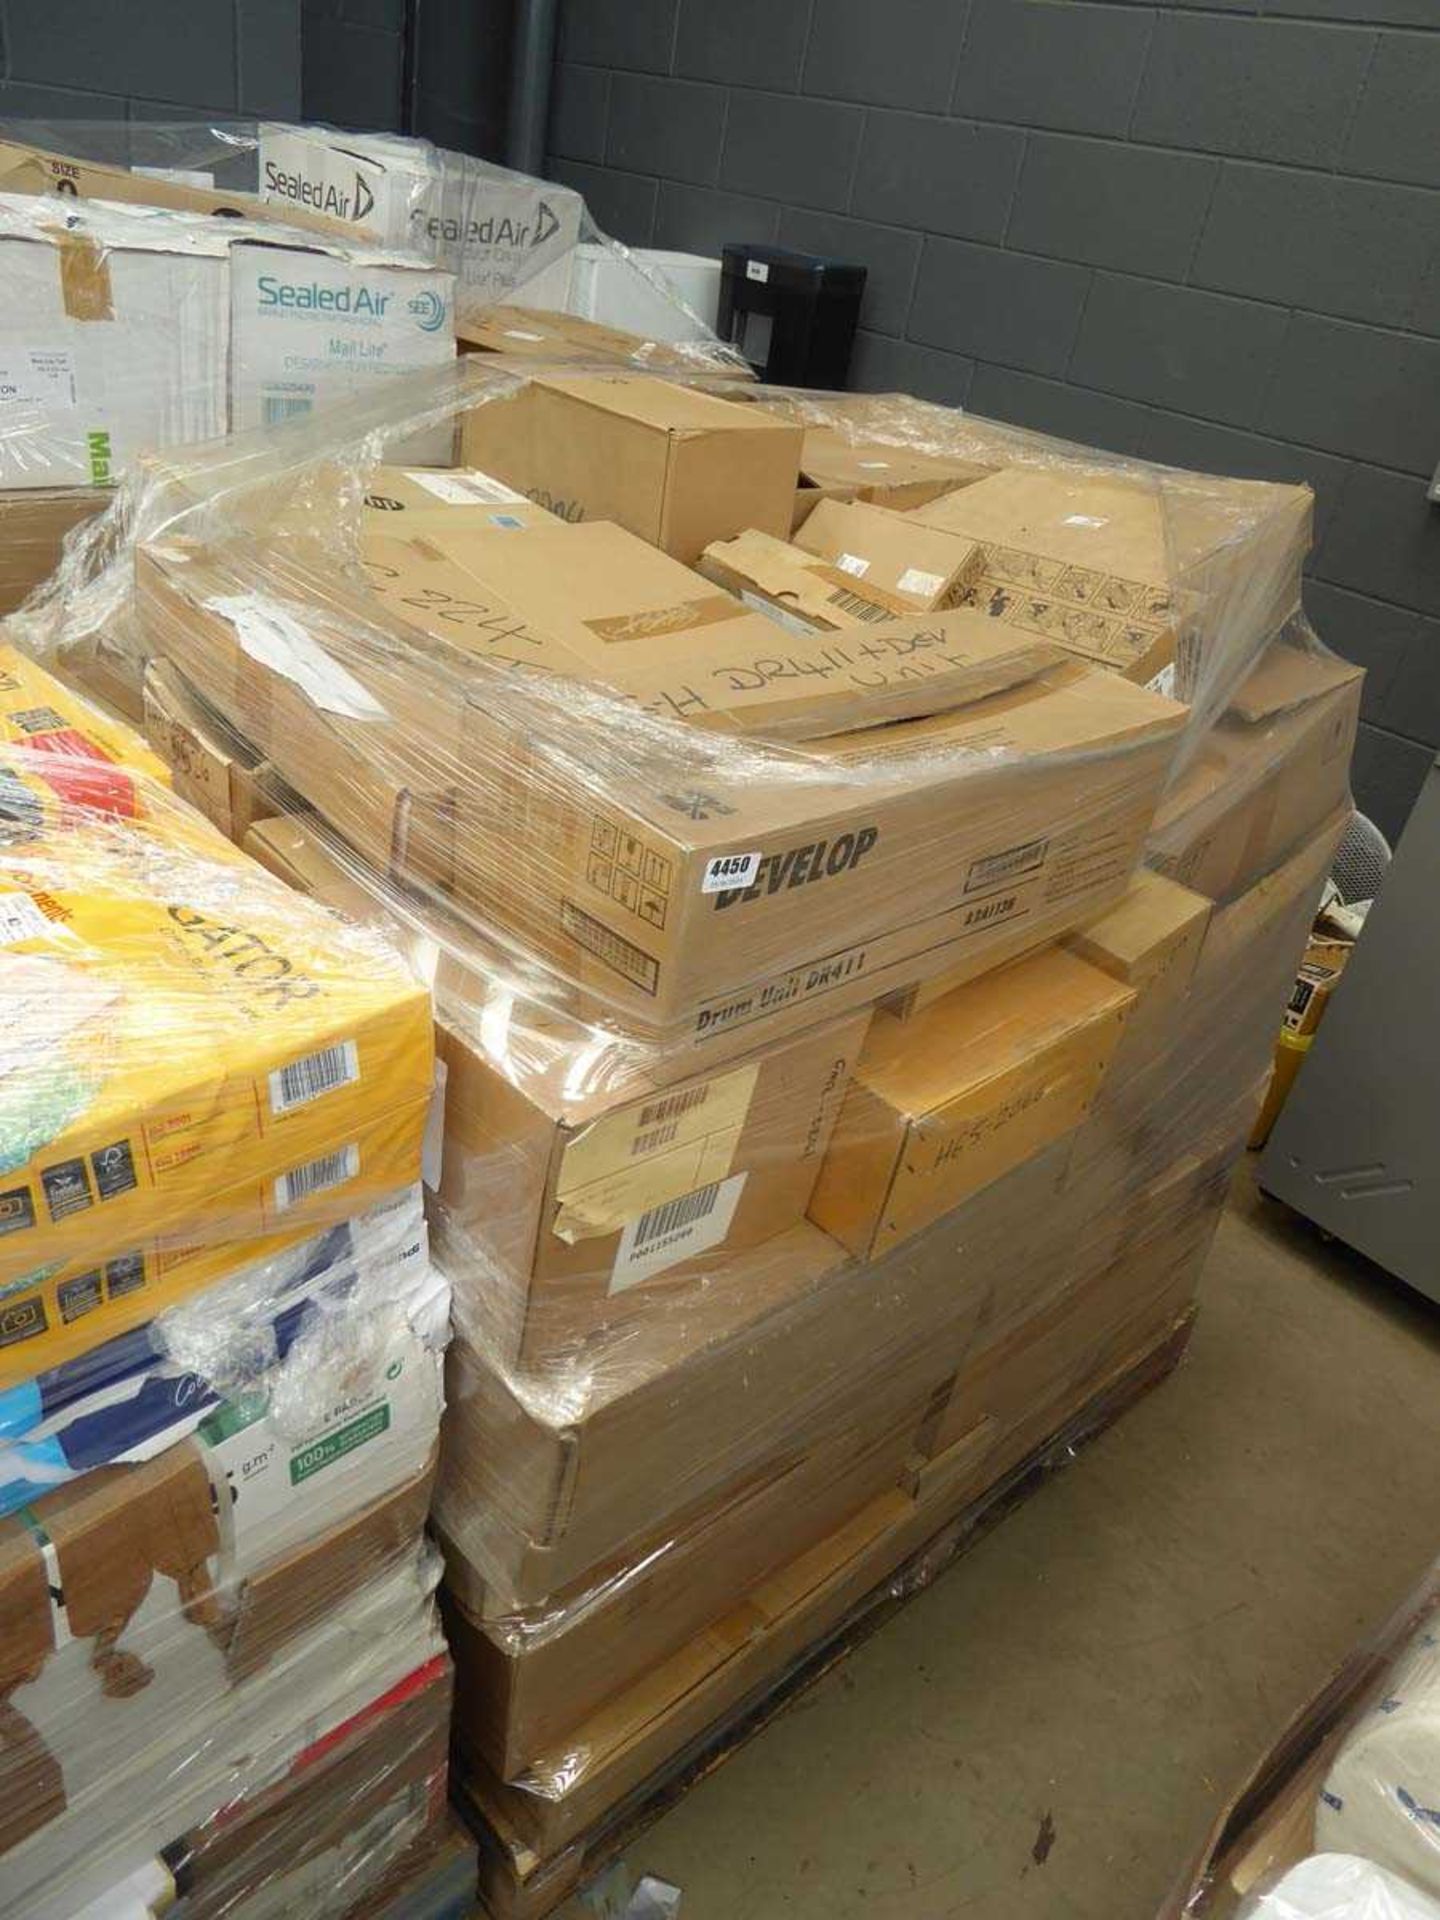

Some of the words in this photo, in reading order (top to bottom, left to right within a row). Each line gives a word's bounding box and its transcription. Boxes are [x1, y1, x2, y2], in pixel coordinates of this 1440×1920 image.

[51, 162, 80, 179] SIZE
[265, 160, 324, 210] Sealed
[323, 184, 352, 219] Air
[495, 217, 530, 249] Air
[257, 276, 350, 313] Sealed
[711, 856, 752, 878] 4450
[696, 998, 753, 1032] Drum
[760, 977, 799, 1008] Unit
[805, 951, 867, 991] DR411
